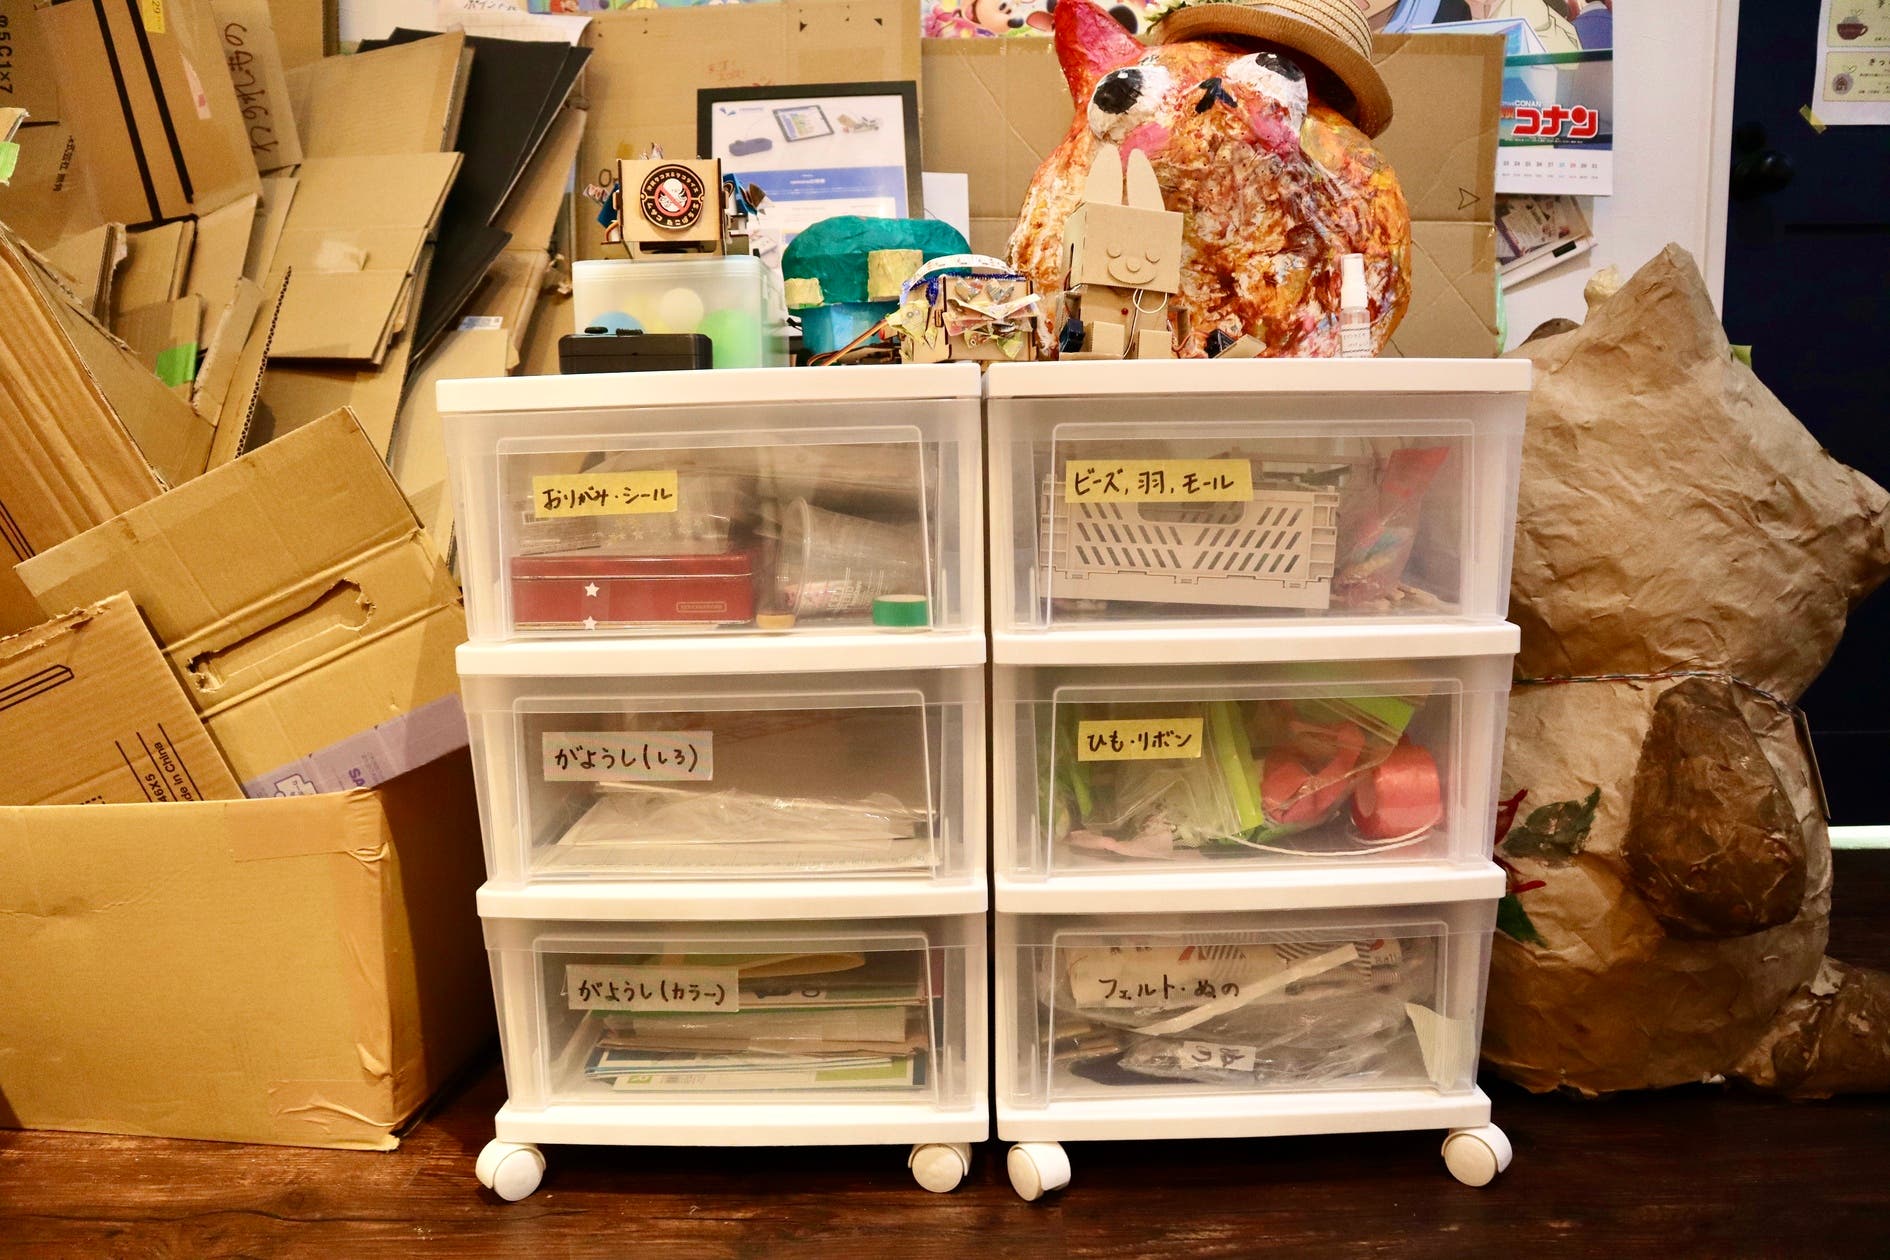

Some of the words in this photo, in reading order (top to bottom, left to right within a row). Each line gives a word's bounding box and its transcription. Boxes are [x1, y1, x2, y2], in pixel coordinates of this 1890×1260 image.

[225, 22, 279, 155] わすれもの
[1511, 105, 1598, 138] コナン
[154, 741, 176, 773] China
